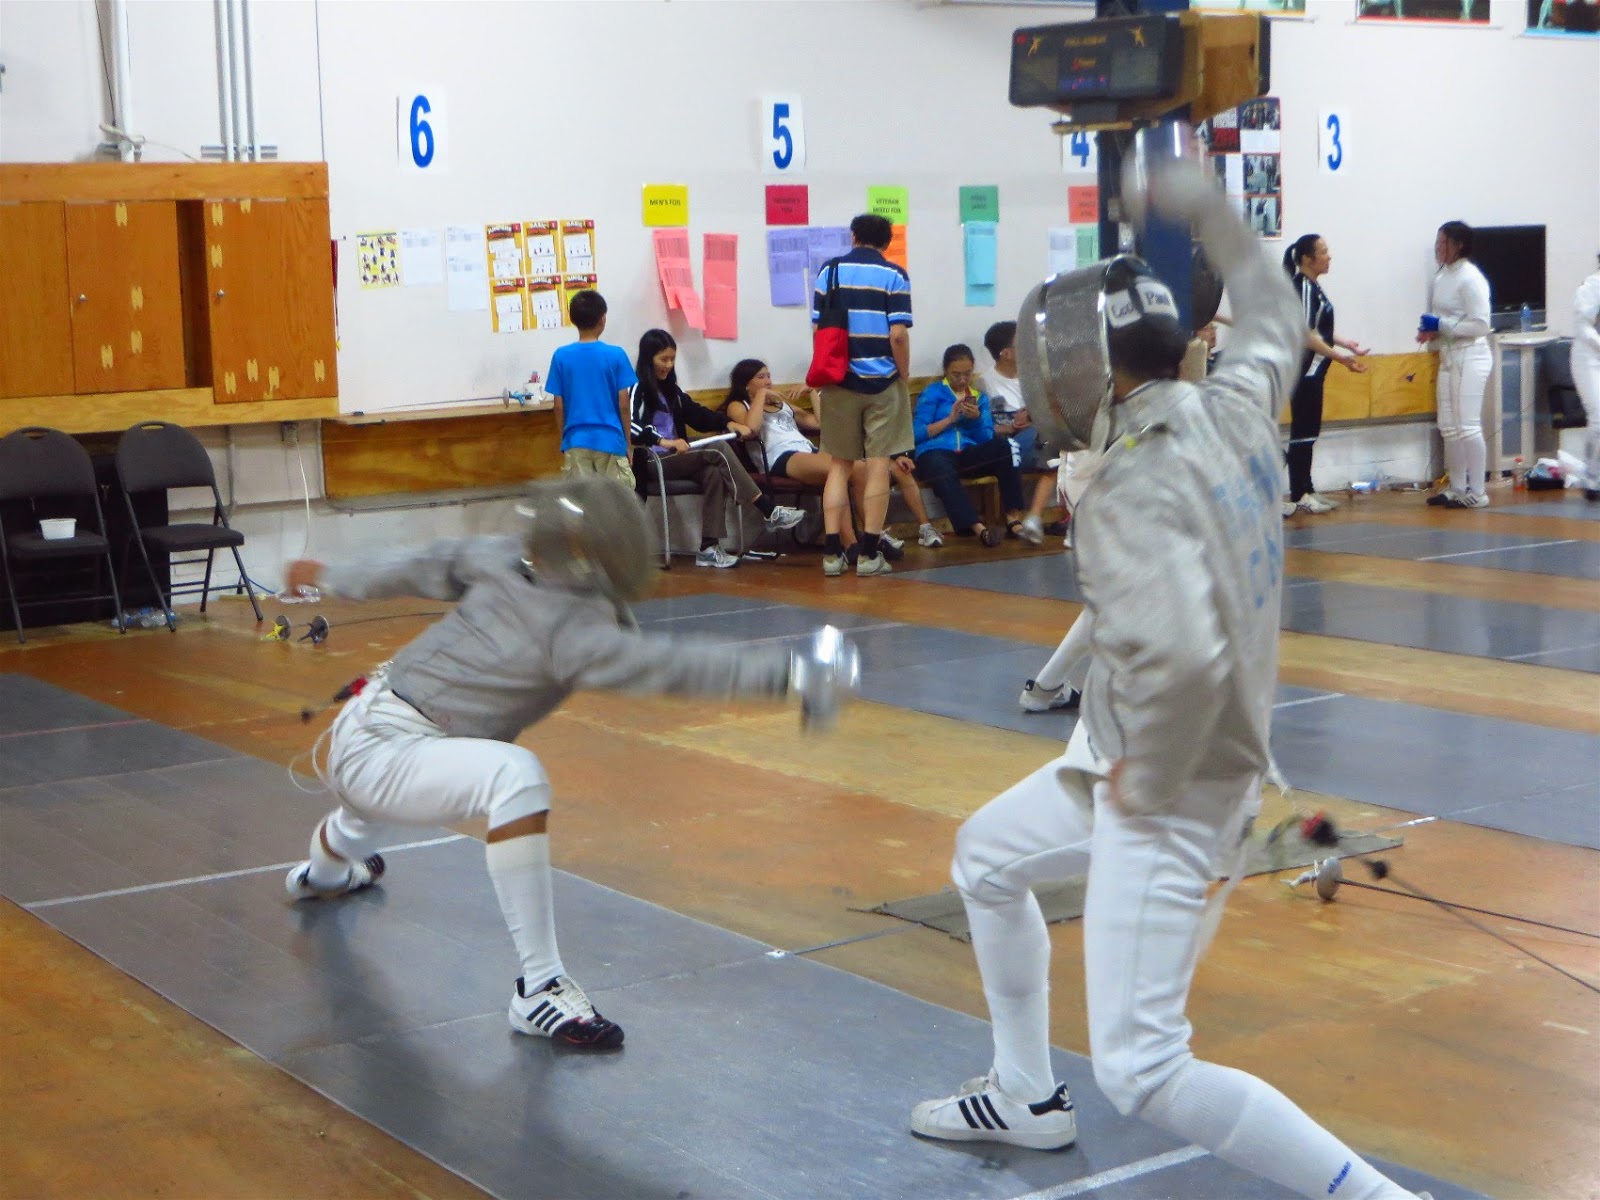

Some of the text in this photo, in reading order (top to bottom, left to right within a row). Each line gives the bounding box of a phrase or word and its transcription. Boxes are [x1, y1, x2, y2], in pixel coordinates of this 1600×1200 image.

[409, 94, 435, 168] 6
[773, 102, 793, 168] 5
[1071, 133, 1090, 166] 4
[1326, 113, 1343, 171] 3
